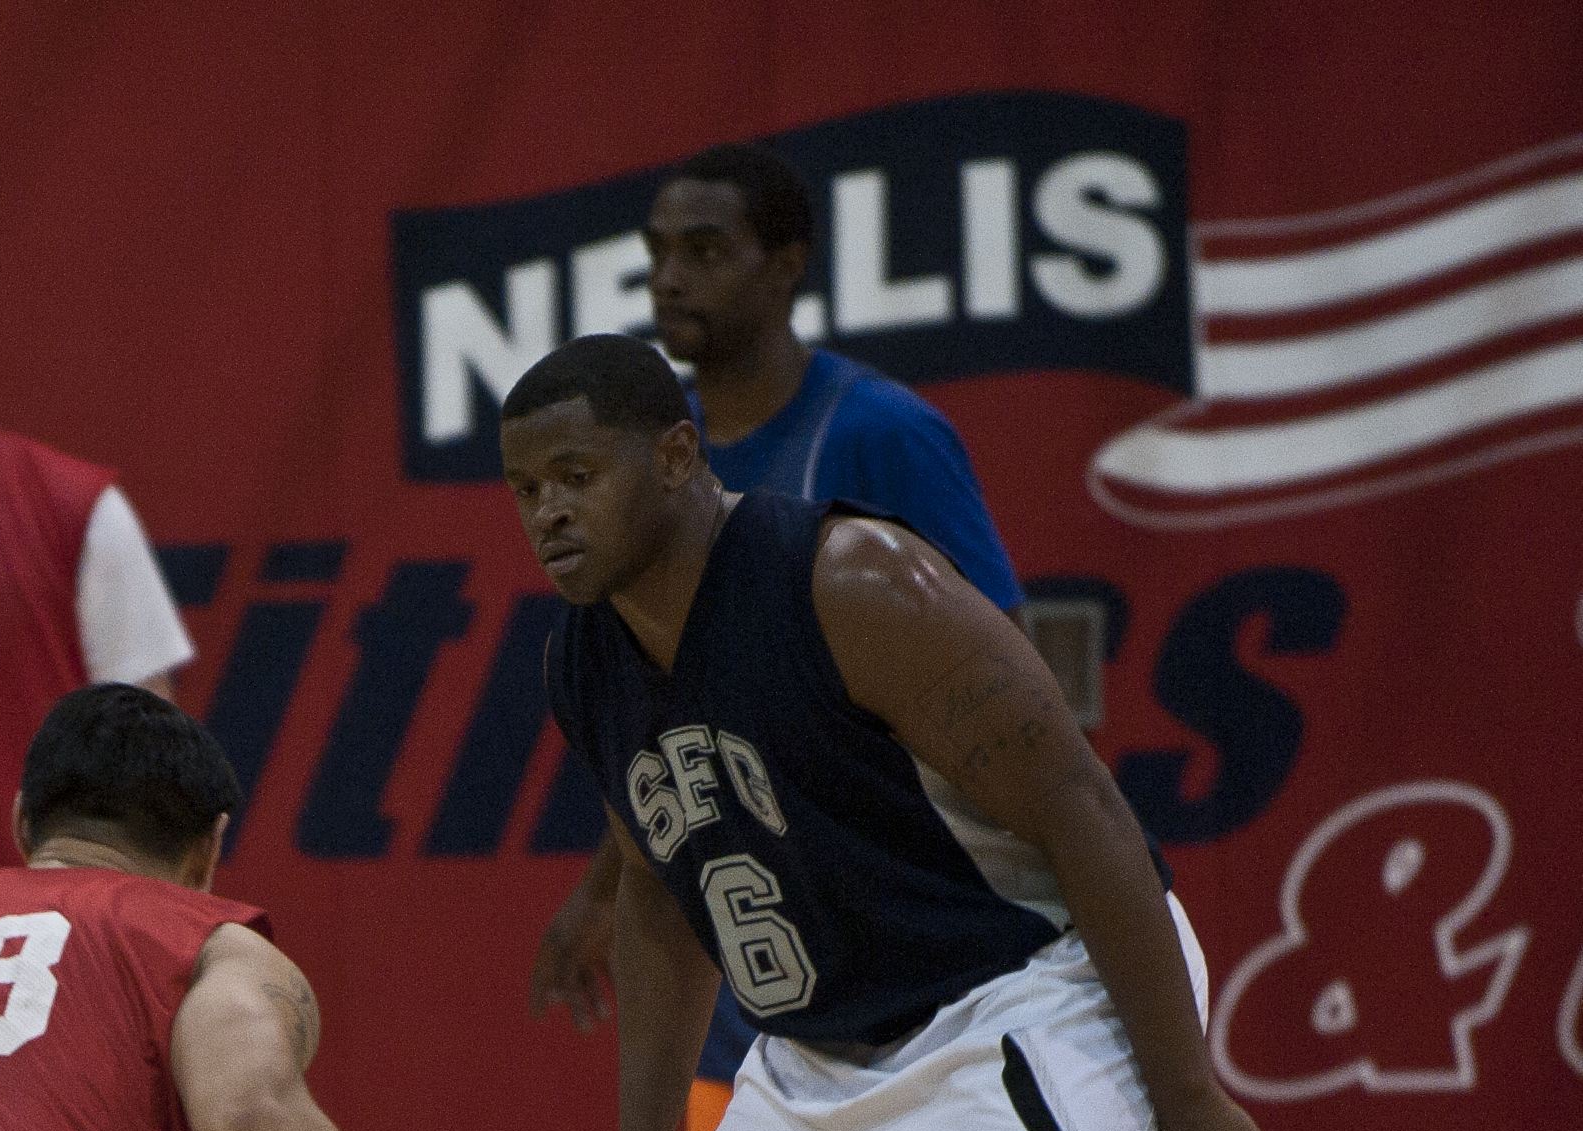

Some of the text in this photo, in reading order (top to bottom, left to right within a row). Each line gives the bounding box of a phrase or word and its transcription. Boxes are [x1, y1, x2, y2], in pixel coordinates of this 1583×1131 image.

[420, 152, 1166, 445] NELIS
[699, 853, 817, 1019] 6
[1212, 780, 1530, 1101] &
